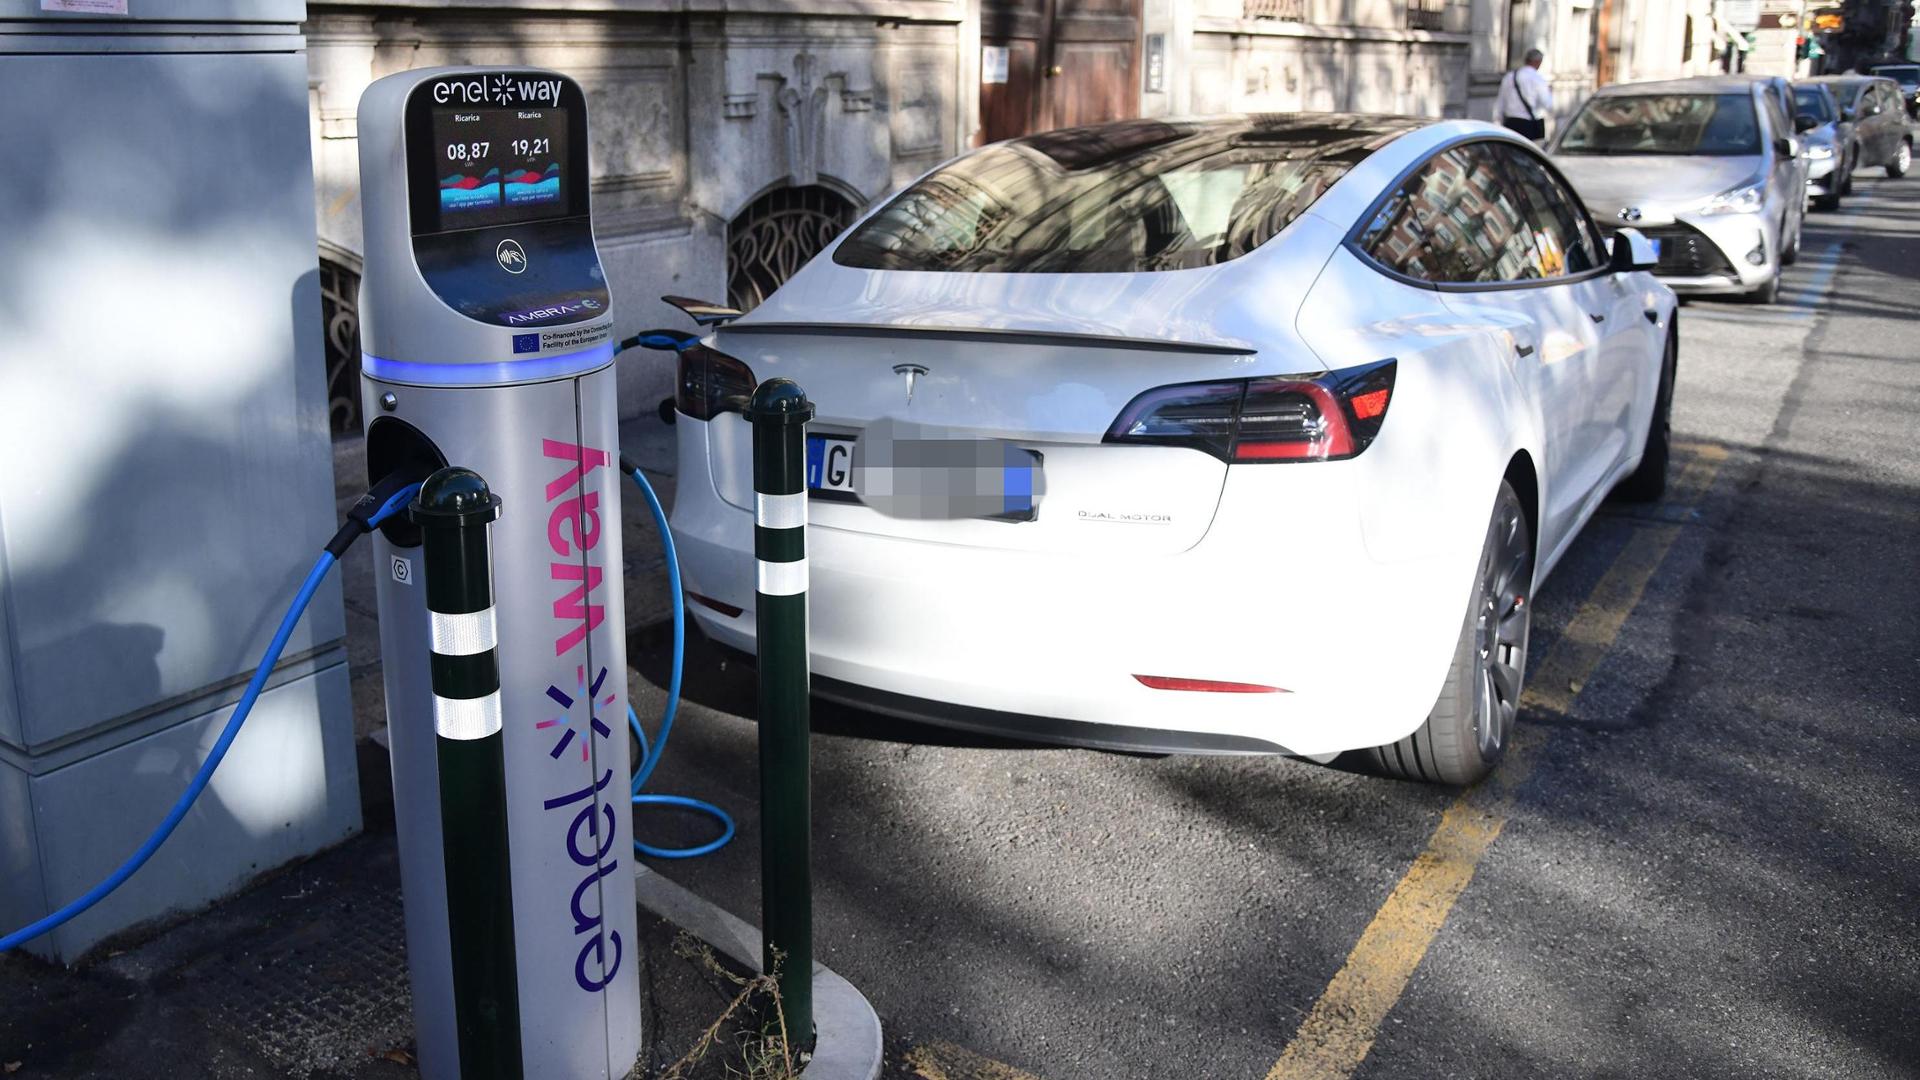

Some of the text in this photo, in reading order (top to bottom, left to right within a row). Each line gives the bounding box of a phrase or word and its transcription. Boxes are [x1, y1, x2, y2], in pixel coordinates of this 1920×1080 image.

[433, 75, 563, 108] enel way
[455, 113, 480, 122] Ricarica
[518, 111, 542, 119] Ricarica
[447, 142, 490, 161] 08,87
[511, 138, 549, 157] 19,21
[542, 331, 576, 341] Co-financed
[576, 329, 583, 337] by
[542, 341, 564, 349] Facility
[1120, 513, 1172, 522] MOTOR
[542, 438, 622, 993] enel way
